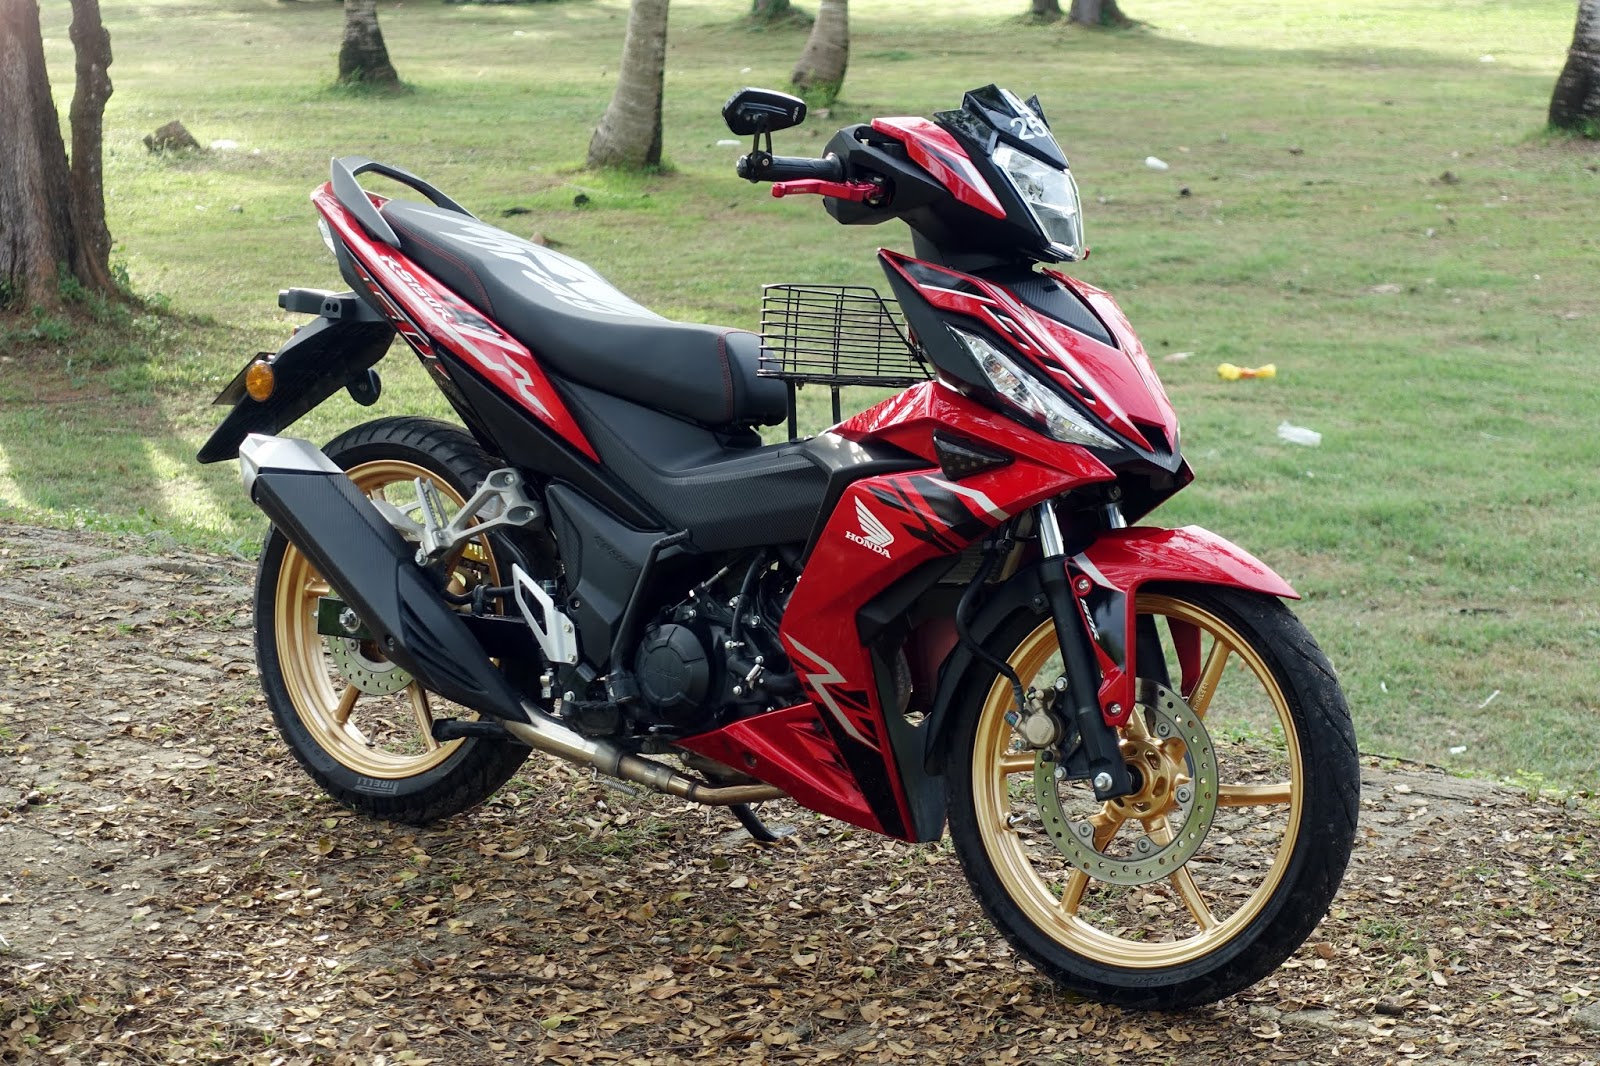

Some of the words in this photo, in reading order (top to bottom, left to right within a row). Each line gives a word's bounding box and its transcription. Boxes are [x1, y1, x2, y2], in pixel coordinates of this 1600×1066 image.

[1010, 117, 1047, 140] 25
[845, 530, 891, 559] HONDA
[354, 776, 400, 795] PIRELLI
